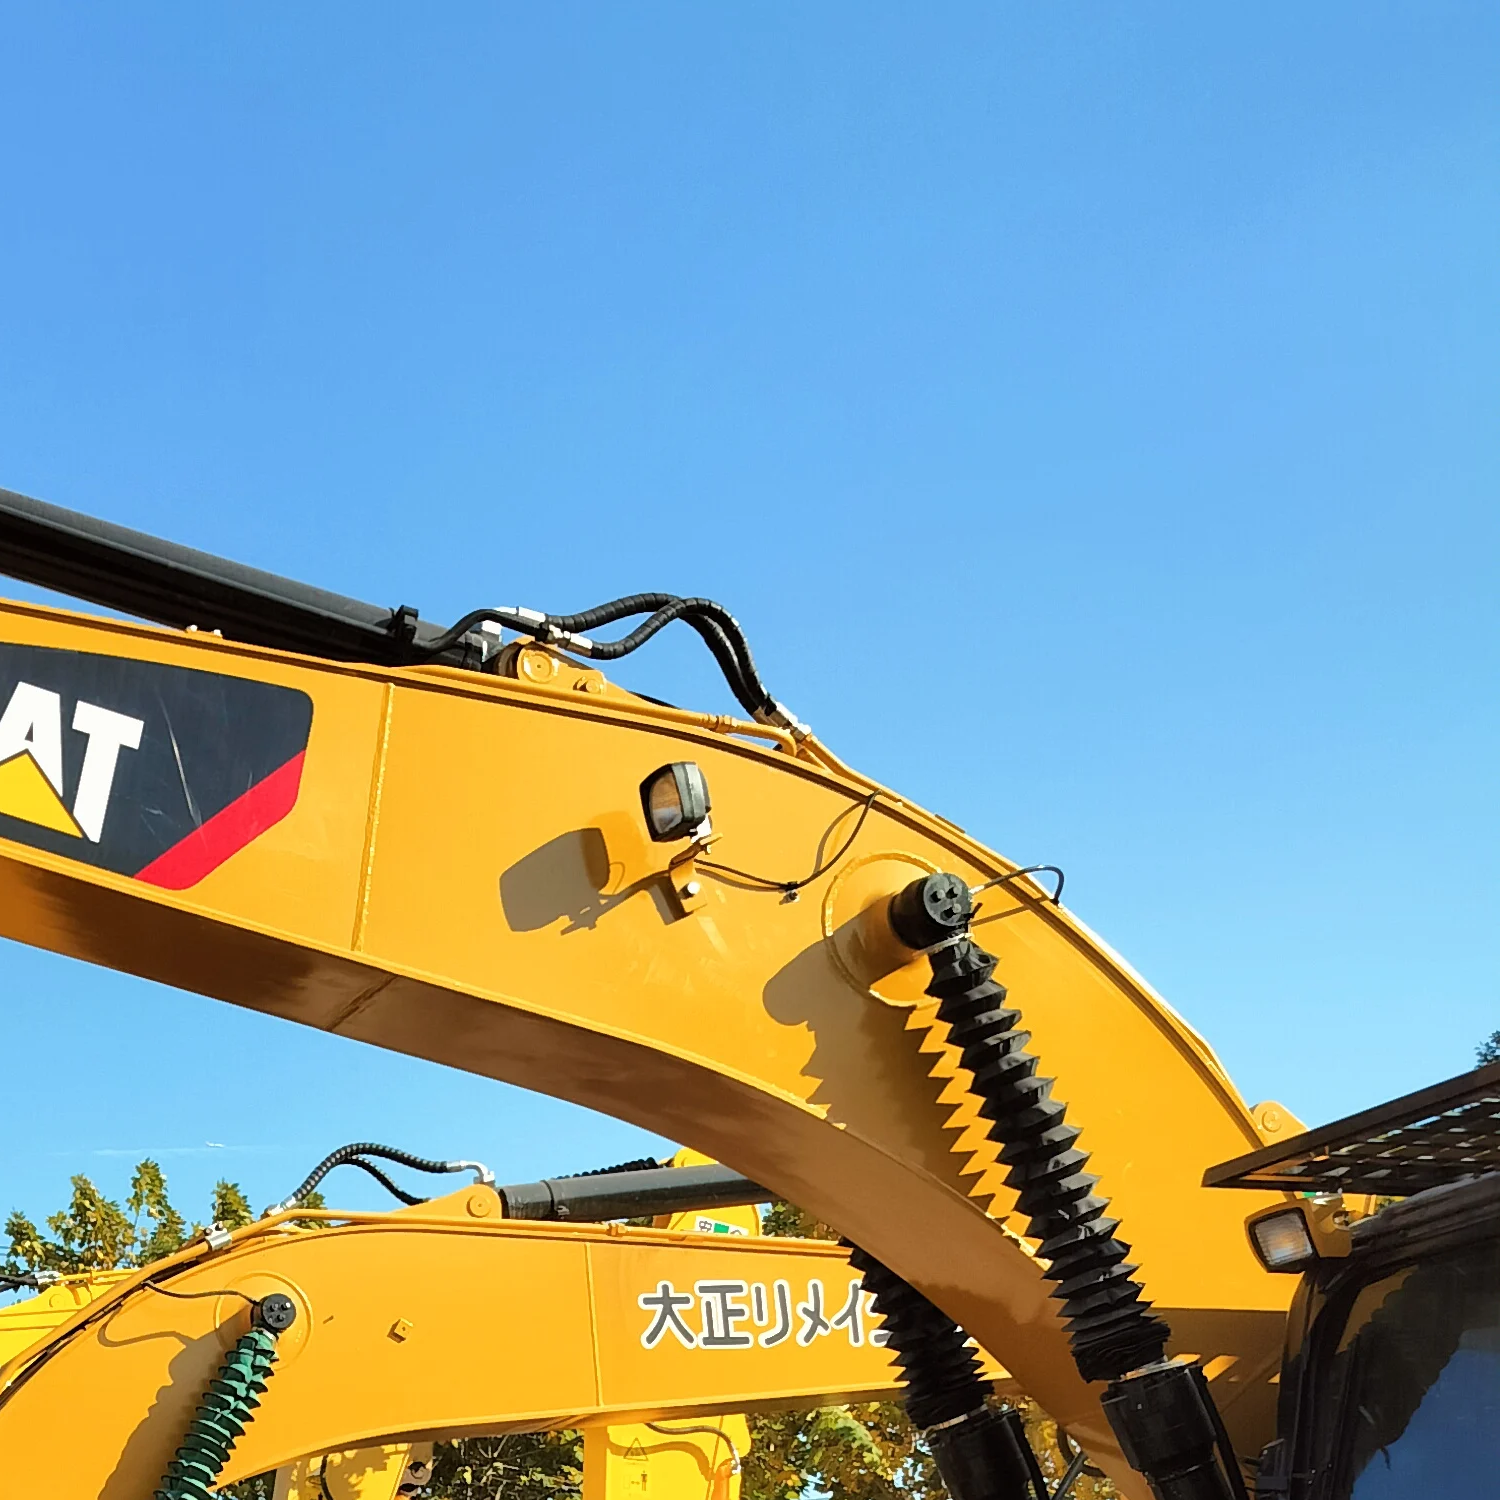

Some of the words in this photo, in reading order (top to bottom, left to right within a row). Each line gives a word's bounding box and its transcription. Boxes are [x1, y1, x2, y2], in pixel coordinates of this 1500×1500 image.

[640, 1282, 894, 1346] 大正リメイ
